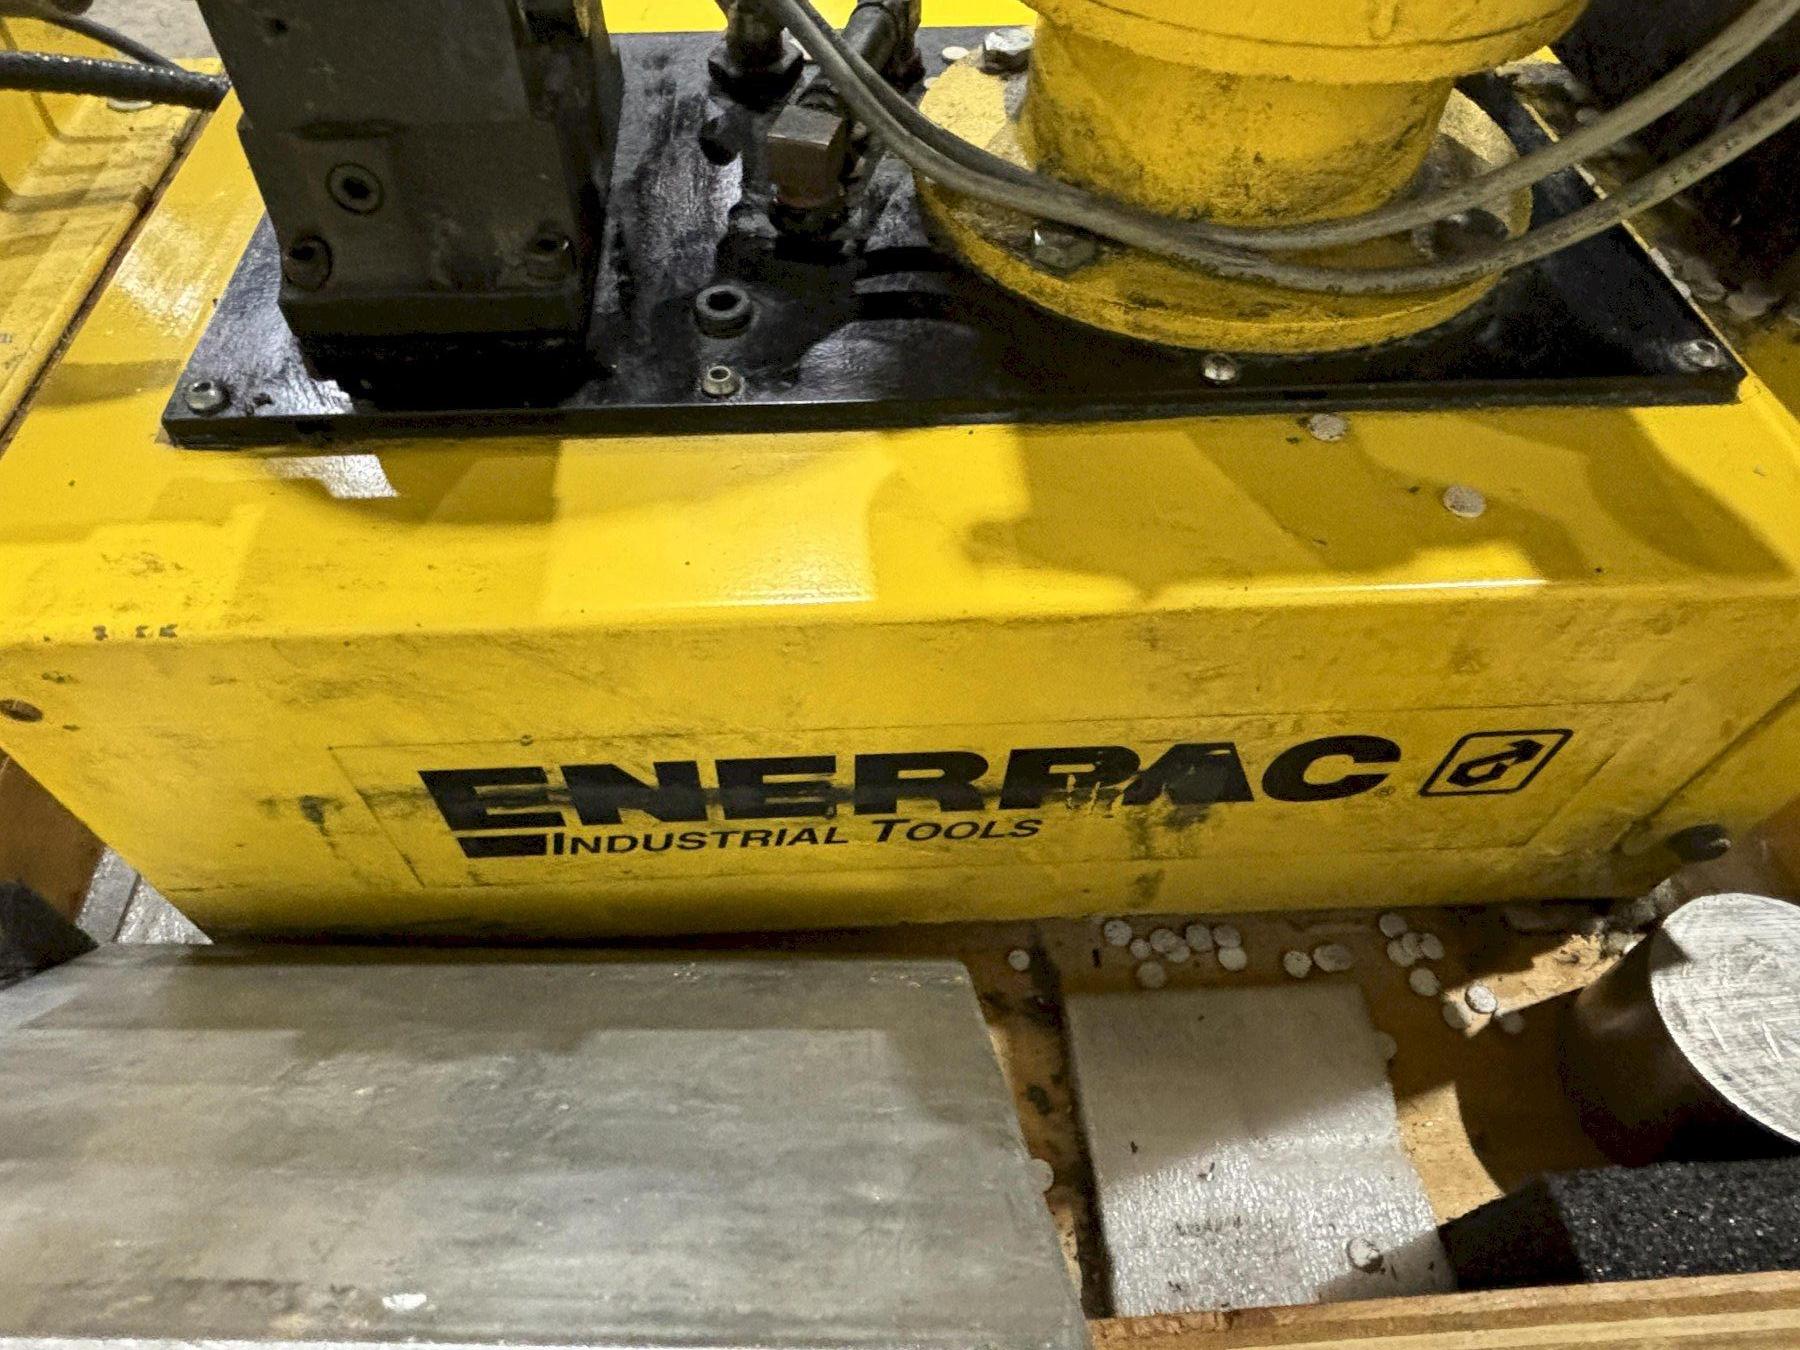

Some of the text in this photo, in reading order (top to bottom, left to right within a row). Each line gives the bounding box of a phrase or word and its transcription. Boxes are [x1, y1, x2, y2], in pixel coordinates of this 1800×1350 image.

[418, 734, 1401, 831] ENERPAC
[552, 819, 1043, 856] INDUSTRIAL TOOLS
